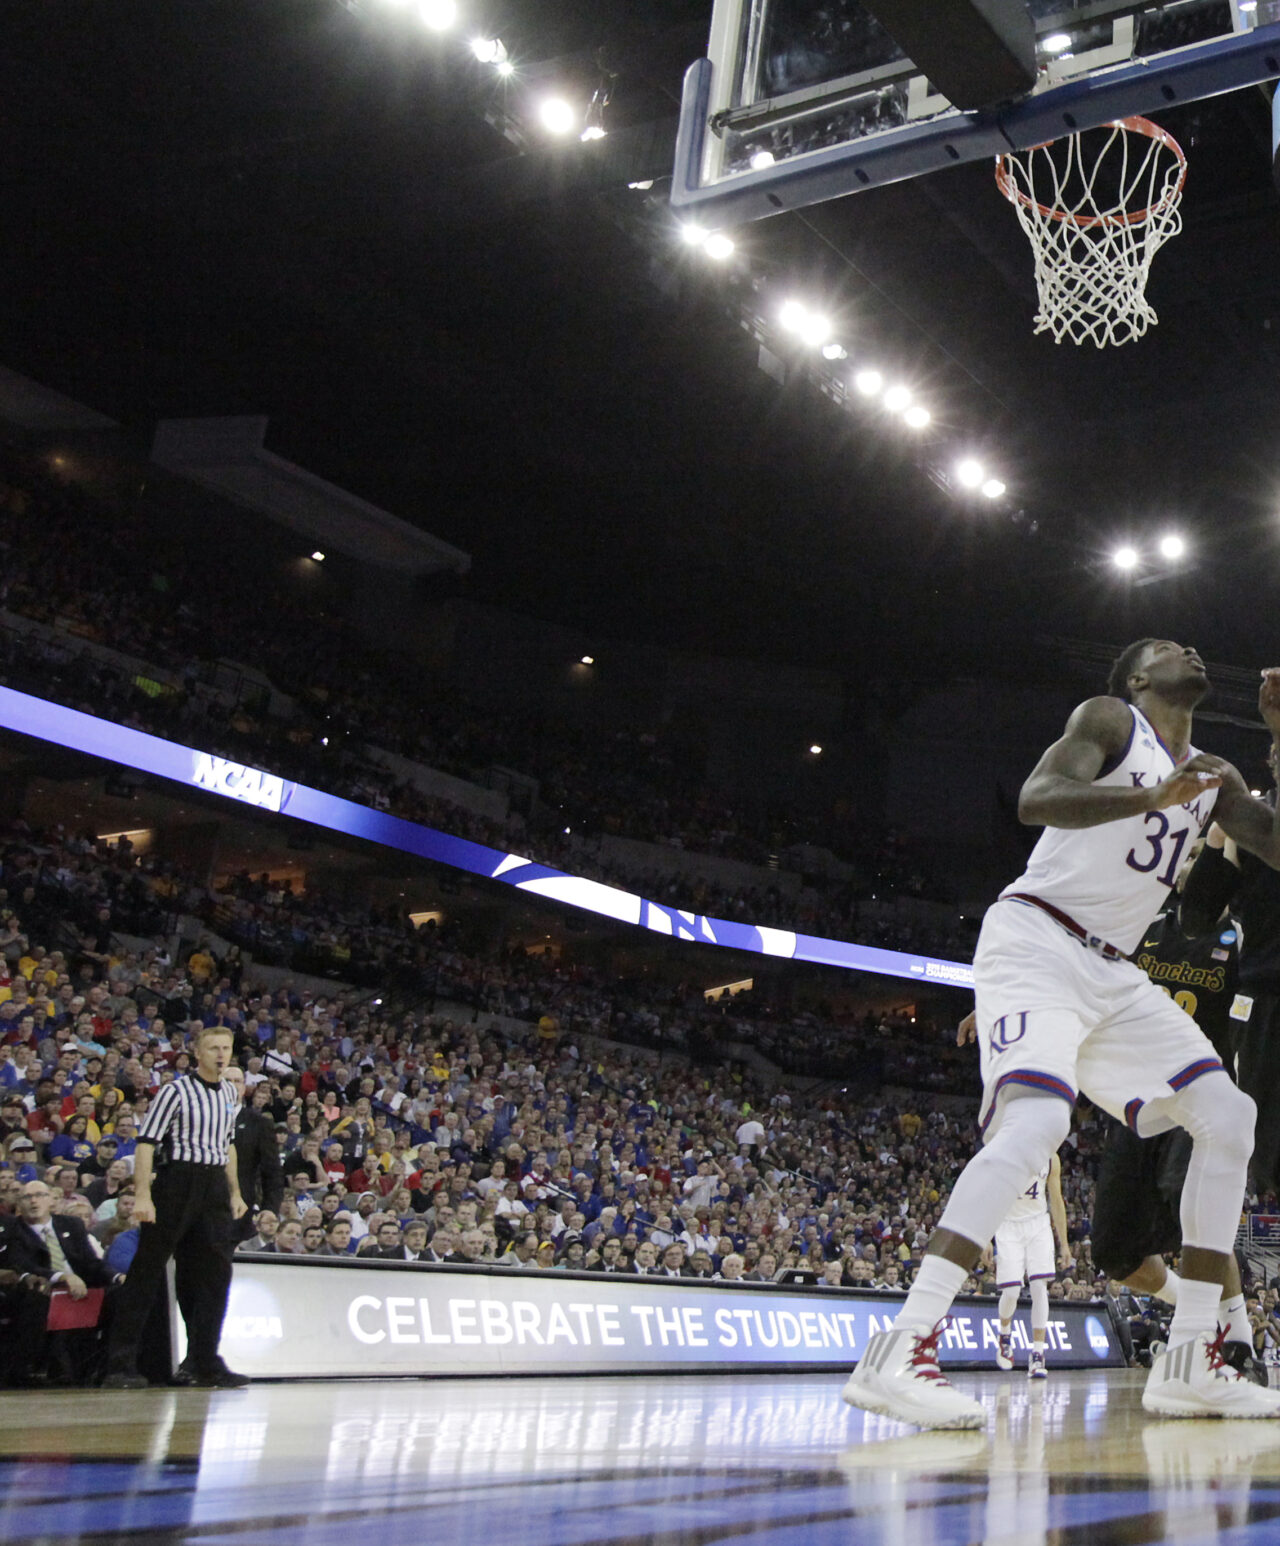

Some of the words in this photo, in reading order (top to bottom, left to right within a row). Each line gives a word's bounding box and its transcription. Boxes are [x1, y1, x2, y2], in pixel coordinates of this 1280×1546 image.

[193, 752, 284, 813] NCAA
[1126, 811, 1190, 888] 31
[1138, 953, 1226, 992] Shockers
[348, 1295, 625, 1346] CELEBRATE
[631, 1305, 708, 1347] THE
[715, 1308, 856, 1348] STUDENT
[937, 1317, 978, 1349] HE
